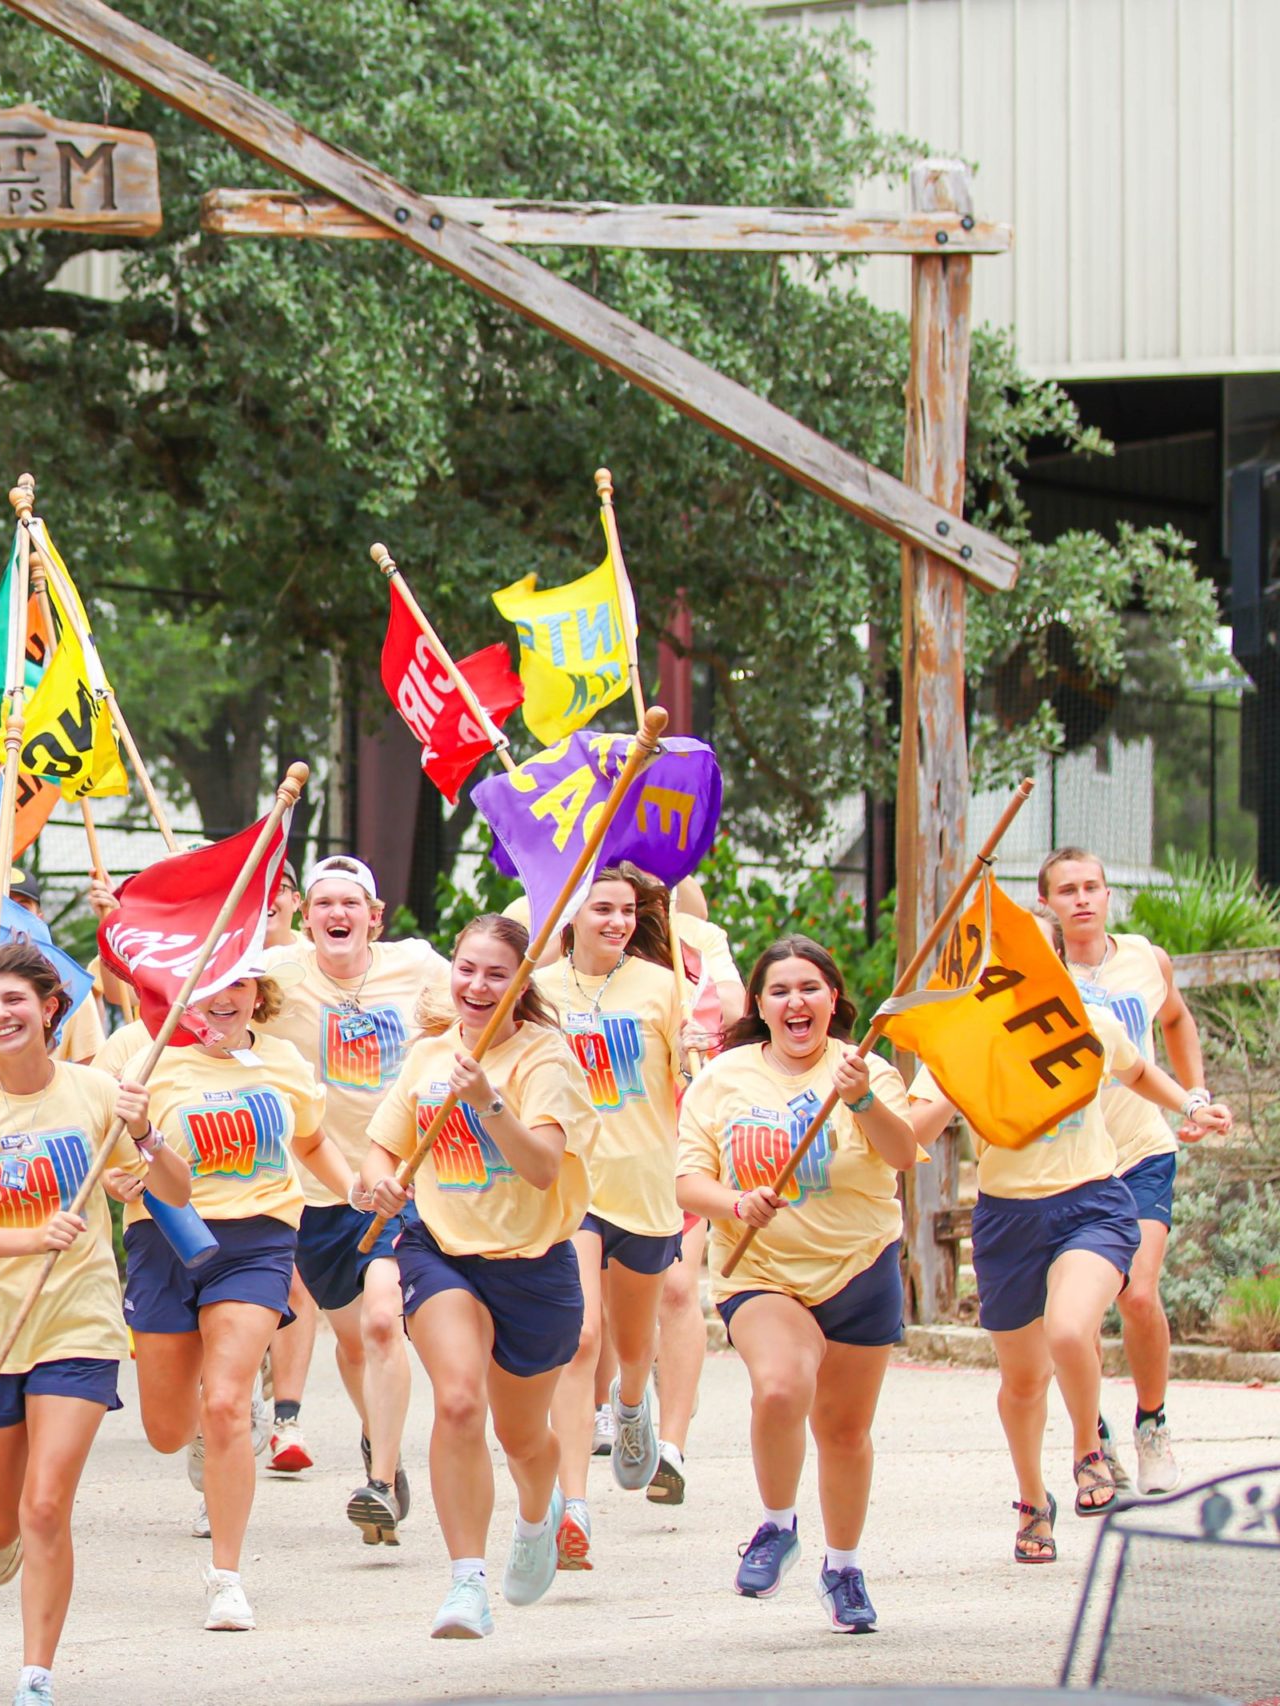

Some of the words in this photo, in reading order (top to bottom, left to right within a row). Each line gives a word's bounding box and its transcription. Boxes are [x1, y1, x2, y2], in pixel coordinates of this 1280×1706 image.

[55, 140, 118, 211] M
[602, 1017, 641, 1094] UP
[1003, 996, 1105, 1090] FE
[243, 1092, 284, 1164] UP
